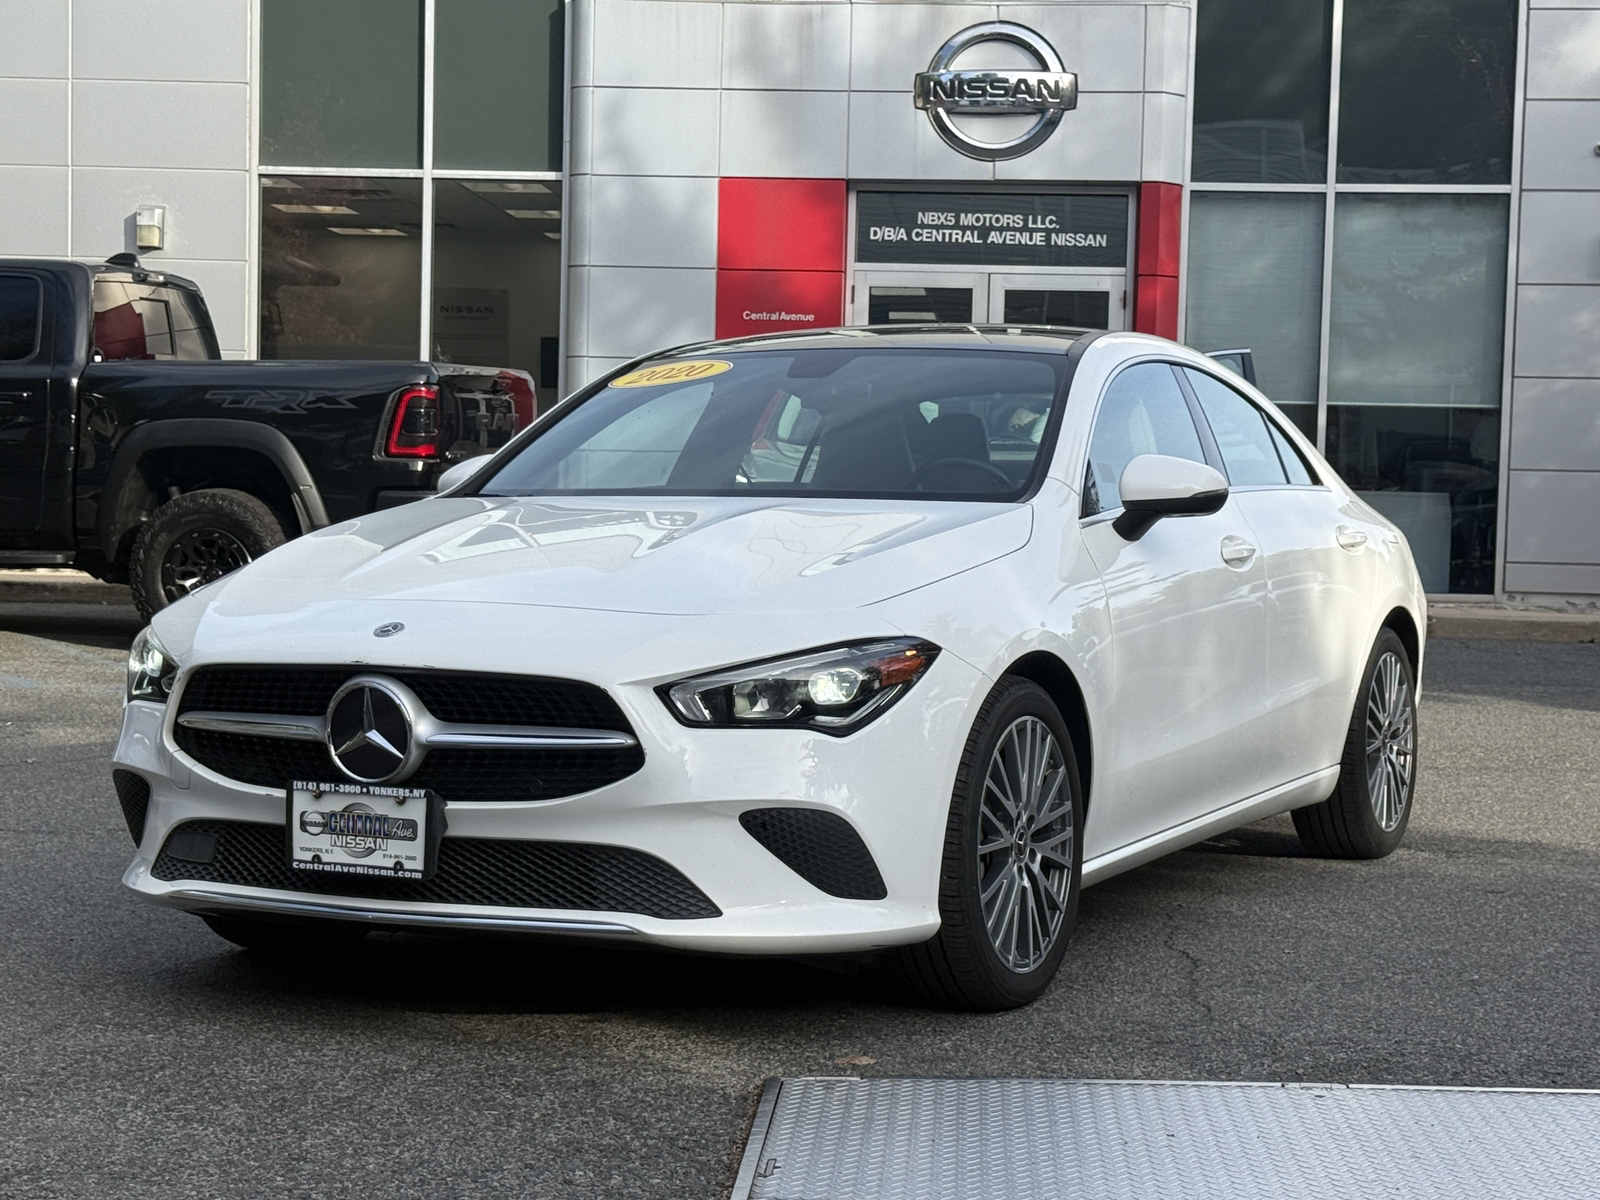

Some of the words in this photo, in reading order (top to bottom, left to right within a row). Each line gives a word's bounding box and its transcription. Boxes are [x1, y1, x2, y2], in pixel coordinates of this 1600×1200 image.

[929, 78, 1061, 102] NISSAN
[917, 212, 956, 226] NBX5
[959, 213, 1024, 229] MOTORS
[1028, 215, 1060, 229] LLC.
[869, 226, 908, 242] D/B/A
[911, 228, 983, 244] CENTRAL
[986, 230, 1046, 246] AVENUE
[1050, 233, 1108, 248] NISSAN
[440, 305, 494, 314] NISSAN
[742, 310, 779, 321] Central
[780, 311, 815, 322] Avenue
[623, 363, 716, 386] 2020
[204, 389, 359, 415] TRX
[328, 810, 390, 837] CENTRAL
[330, 834, 389, 851] NISSAN
